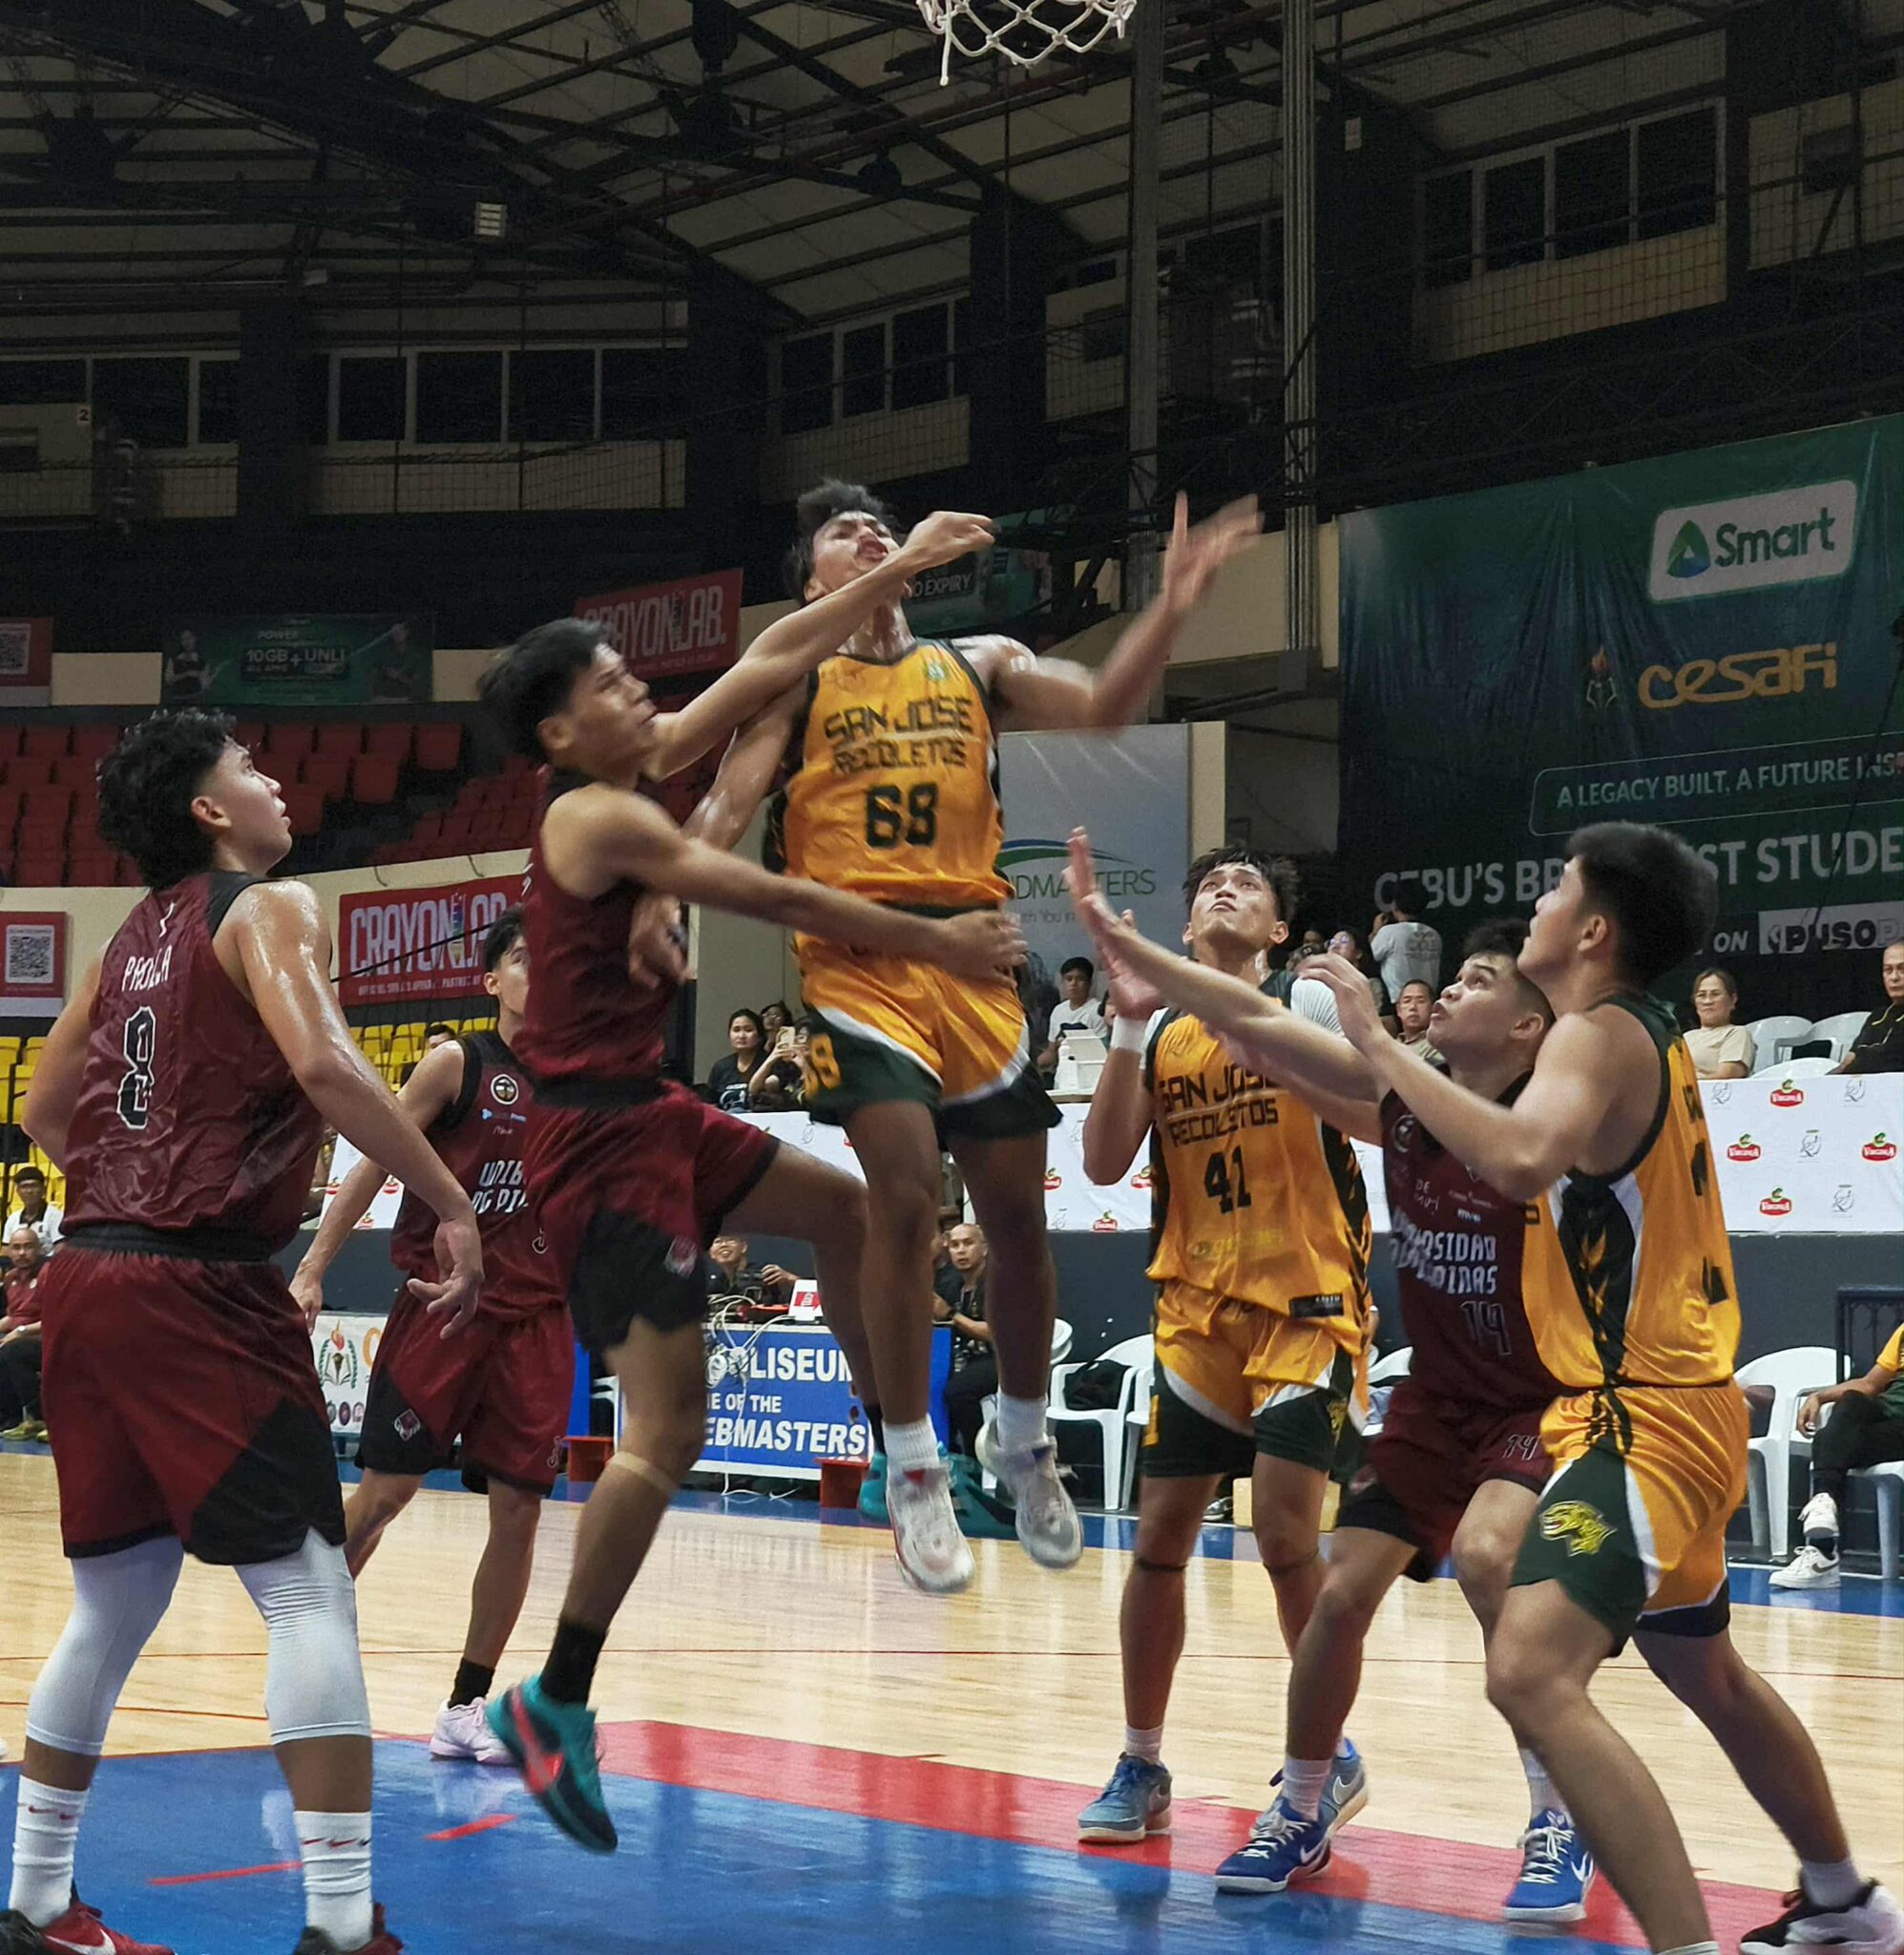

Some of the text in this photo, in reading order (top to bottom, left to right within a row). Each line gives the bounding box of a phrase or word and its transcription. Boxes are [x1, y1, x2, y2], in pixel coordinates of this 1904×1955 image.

[79, 409, 89, 421] 2
[1715, 506, 1836, 568] Smart
[924, 573, 973, 597] EXPIRY
[246, 648, 289, 663] 10GB
[304, 648, 345, 662] UNLI
[824, 696, 974, 742] SAN JOSE
[1557, 786, 1574, 809] A
[1579, 775, 1660, 807] LEGACY
[1736, 767, 1753, 792] A
[1758, 756, 1851, 789] FUTURE
[1373, 861, 1505, 913] CBU'S
[1713, 930, 1748, 955] ON
[1158, 1072, 1208, 1113] SAN
[1203, 1146, 1252, 1215] 41
[725, 1394, 746, 1412] OF
[749, 1395, 783, 1414] THE
